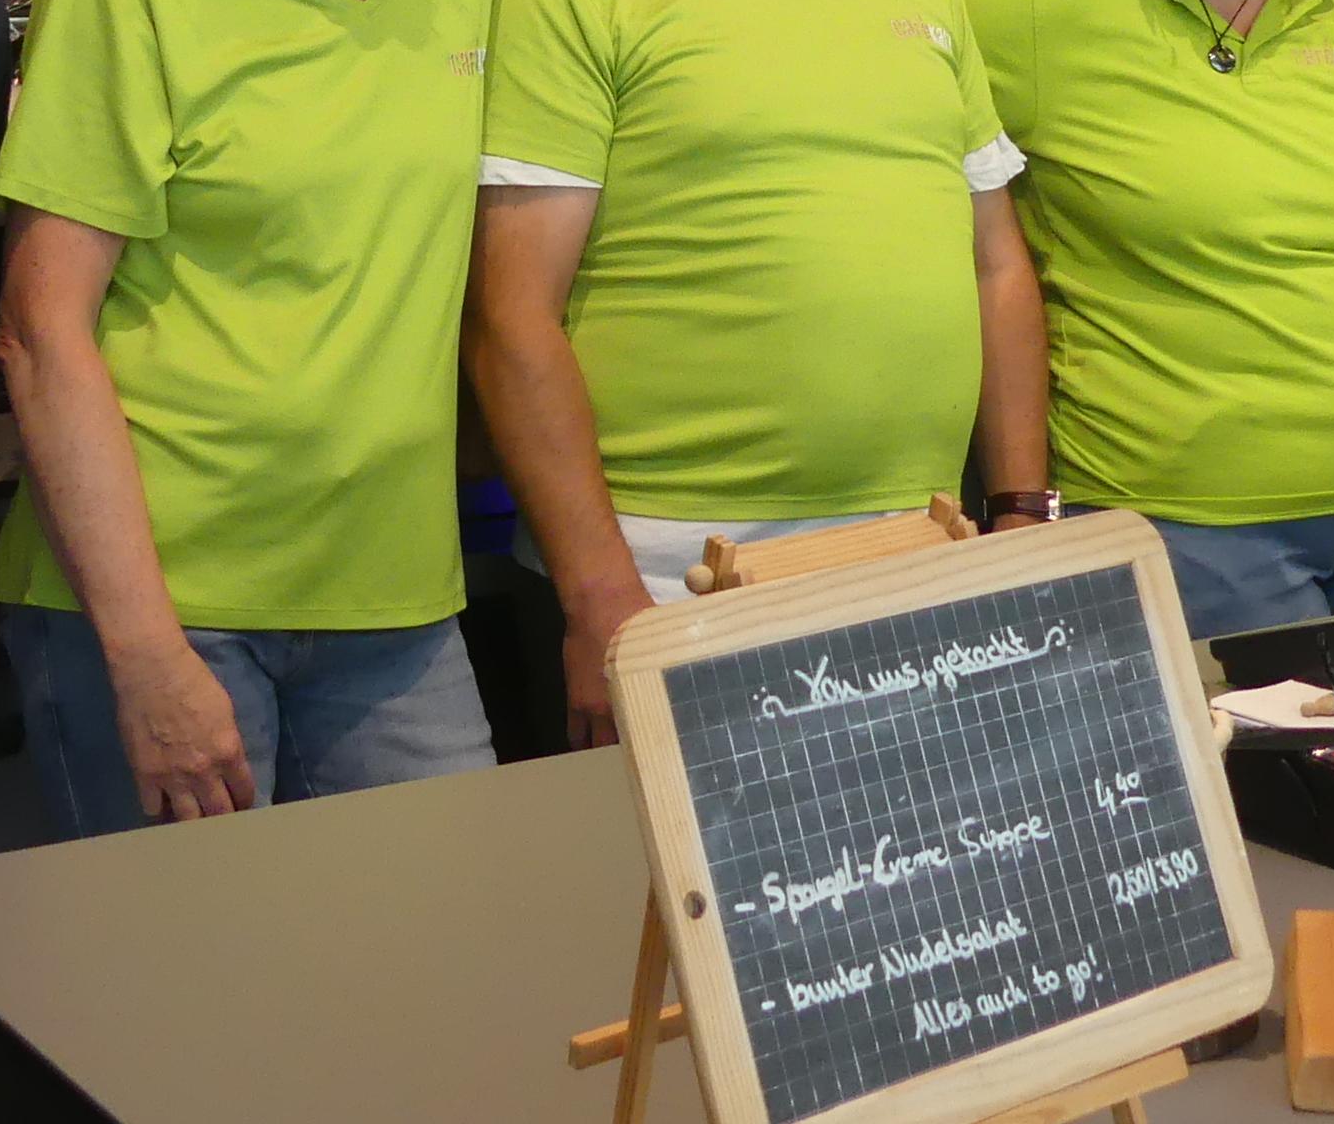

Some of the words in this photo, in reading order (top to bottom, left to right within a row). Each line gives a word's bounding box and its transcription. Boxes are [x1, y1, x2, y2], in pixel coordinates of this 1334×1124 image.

[868, 661, 919, 689] uns
[933, 626, 1029, 690] gekocht
[958, 817, 1051, 858] Suppe
[787, 963, 874, 1011] bunter
[880, 908, 1027, 981] Nudelsalat
[913, 997, 971, 1040] Alles
[976, 976, 1028, 1016] auch
[1033, 965, 1060, 995] to
[1066, 943, 1103, 1001] go!
